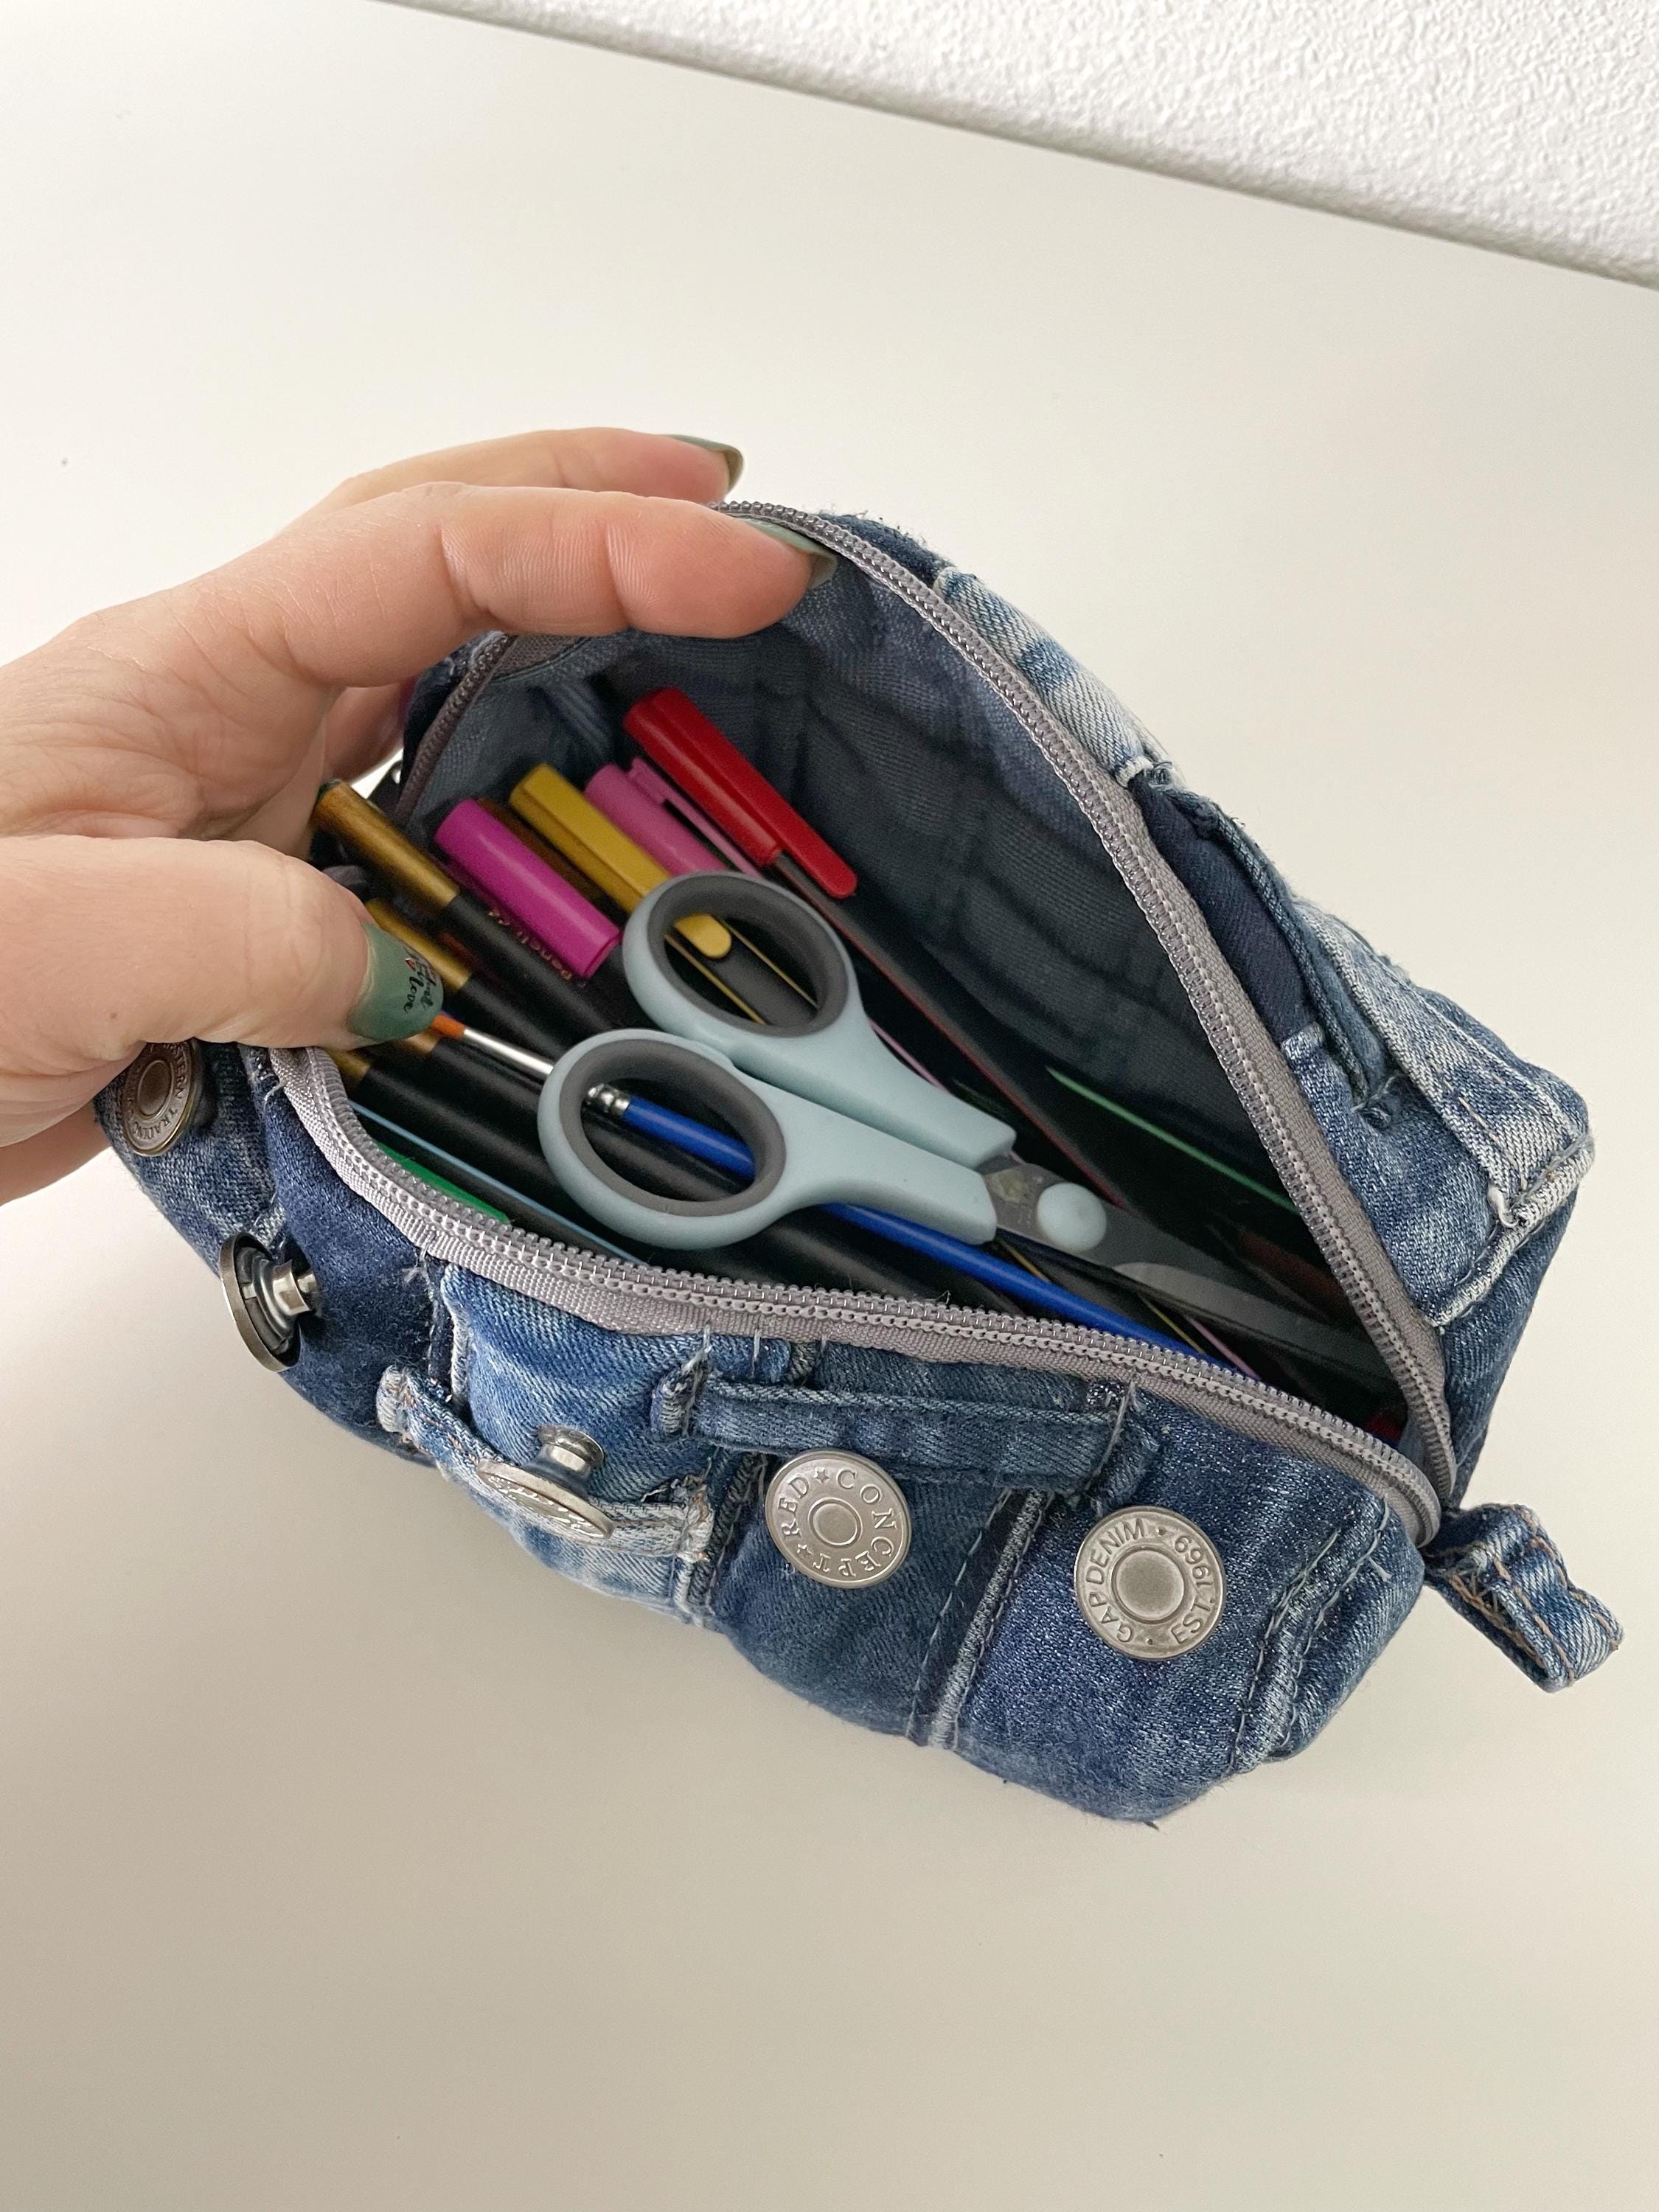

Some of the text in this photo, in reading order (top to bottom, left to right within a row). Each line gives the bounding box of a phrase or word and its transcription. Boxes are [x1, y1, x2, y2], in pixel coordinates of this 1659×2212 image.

[778, 1467, 897, 1577] RED CONCEPT
[1085, 1518, 1145, 1643] GAP DENIM
[1170, 1535, 1215, 1644] EST. 1969
